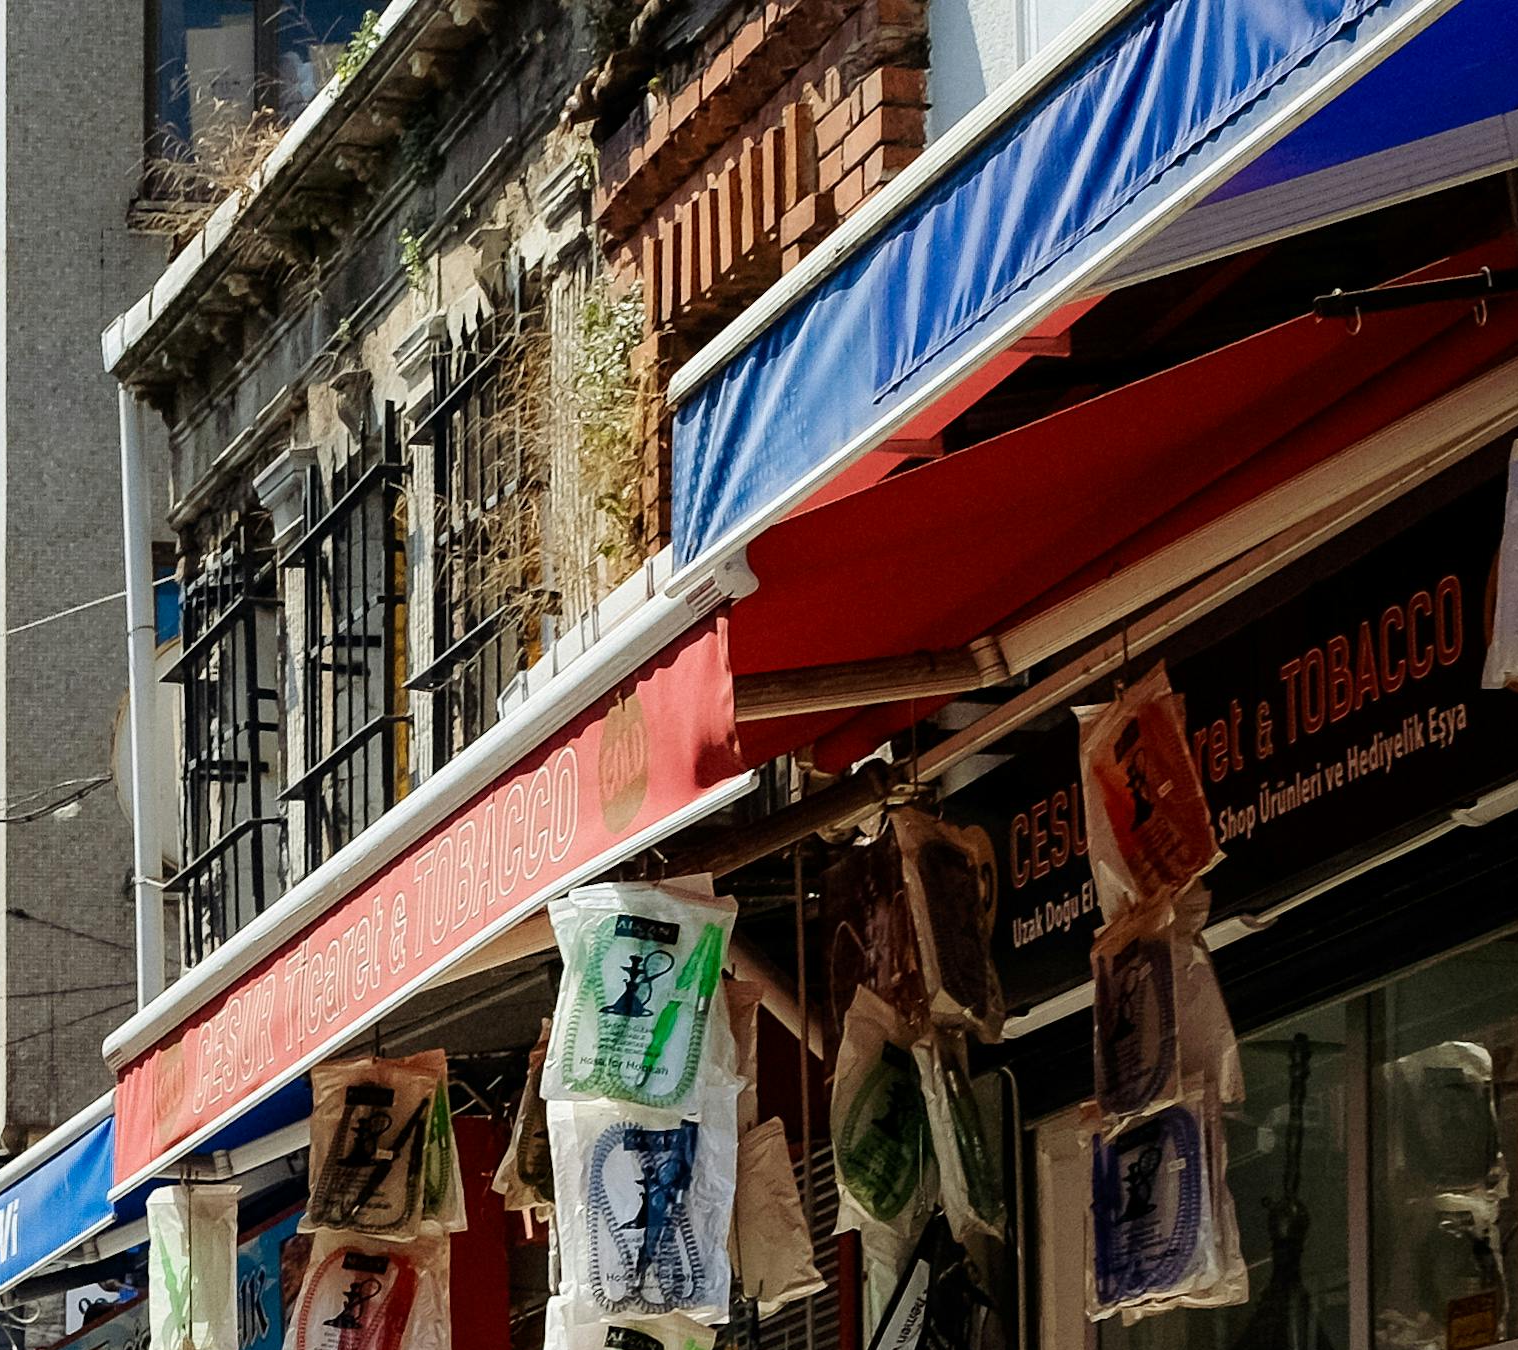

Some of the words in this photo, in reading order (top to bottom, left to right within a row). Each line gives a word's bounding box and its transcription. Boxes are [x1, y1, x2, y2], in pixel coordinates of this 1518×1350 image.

[1280, 575, 1463, 744] TOBACCO
[192, 972, 277, 1115] CESUR
[390, 893, 409, 974] &
[412, 747, 580, 959] TOBACCO
[1012, 910, 1043, 948] Uzak
[1045, 892, 1082, 933] Doğu
[1218, 807, 1257, 845] Shop
[1259, 774, 1323, 824] Ürünleri
[1325, 765, 1344, 791] ve
[1346, 722, 1425, 780] Hediyelik
[1428, 702, 1468, 746] Eşya
